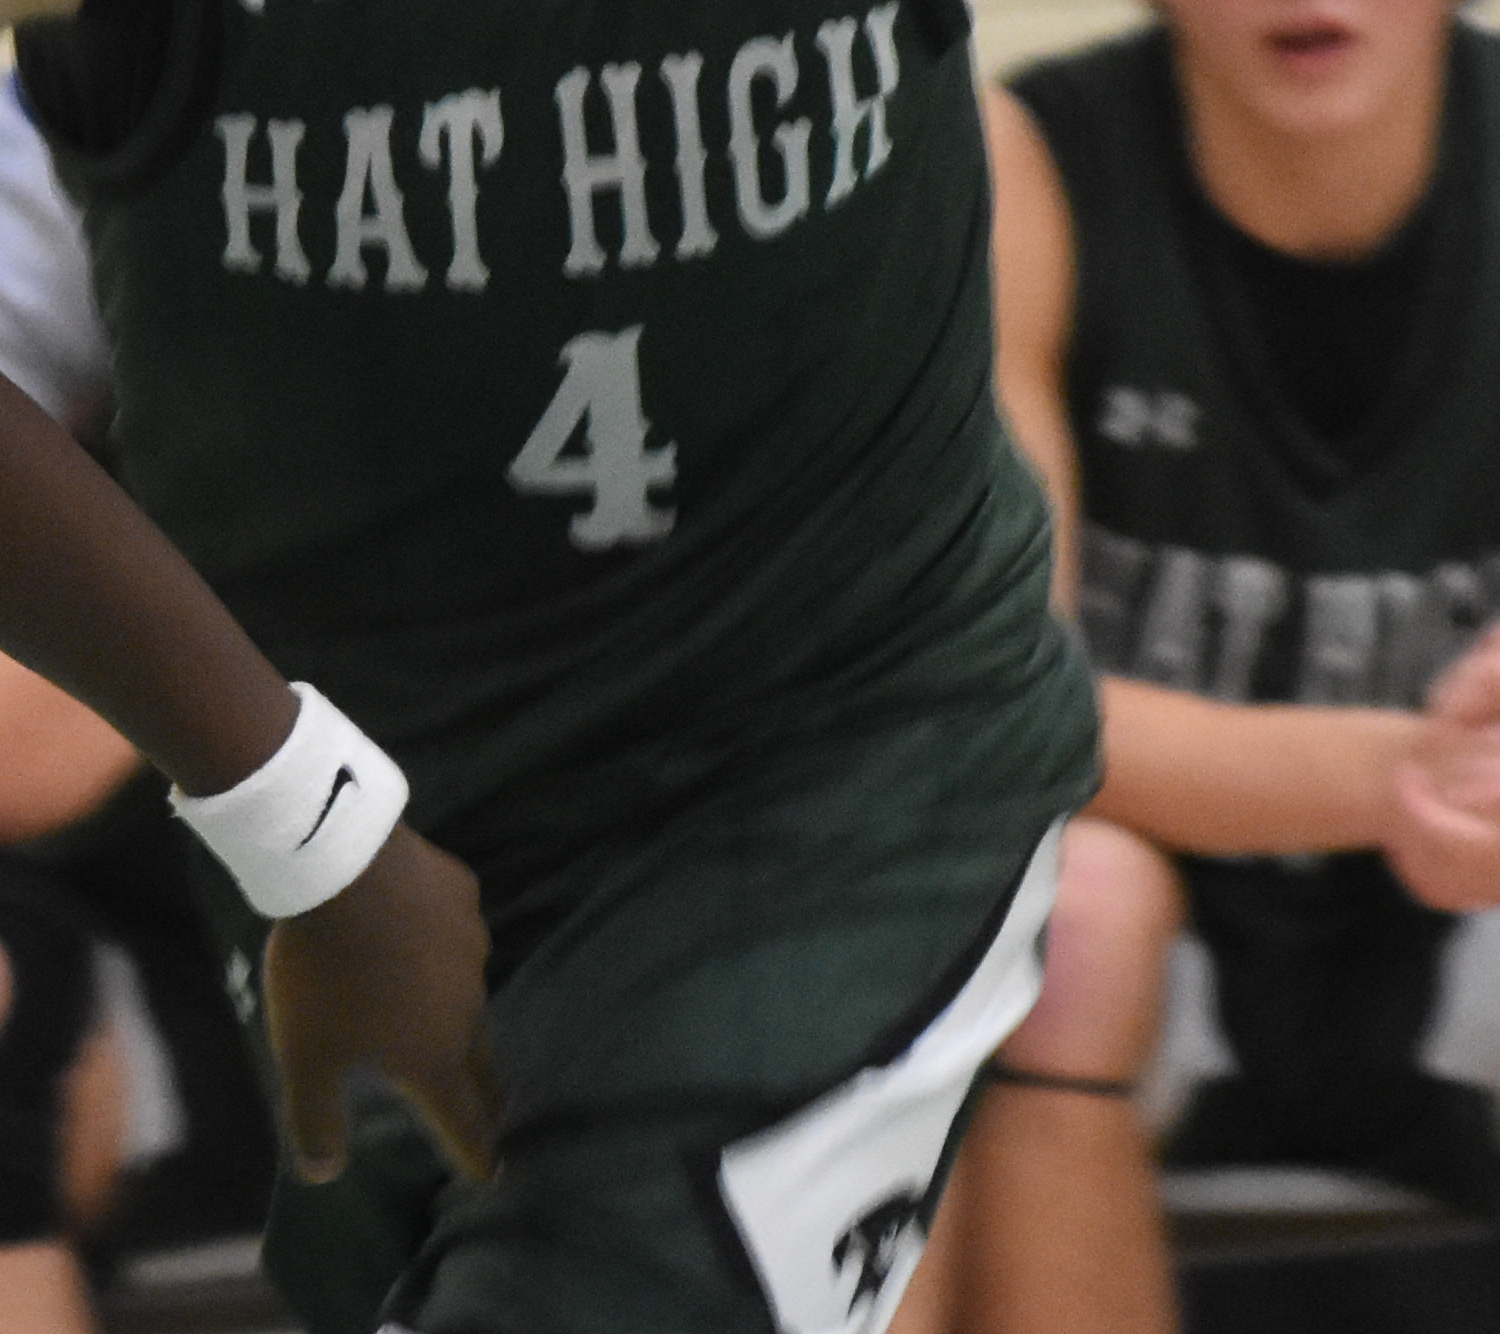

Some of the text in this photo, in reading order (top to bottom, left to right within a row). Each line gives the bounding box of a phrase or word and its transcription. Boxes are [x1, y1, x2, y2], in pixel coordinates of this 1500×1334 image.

[214, 0, 901, 295] HAT HIGH
[504, 323, 679, 552] 4
